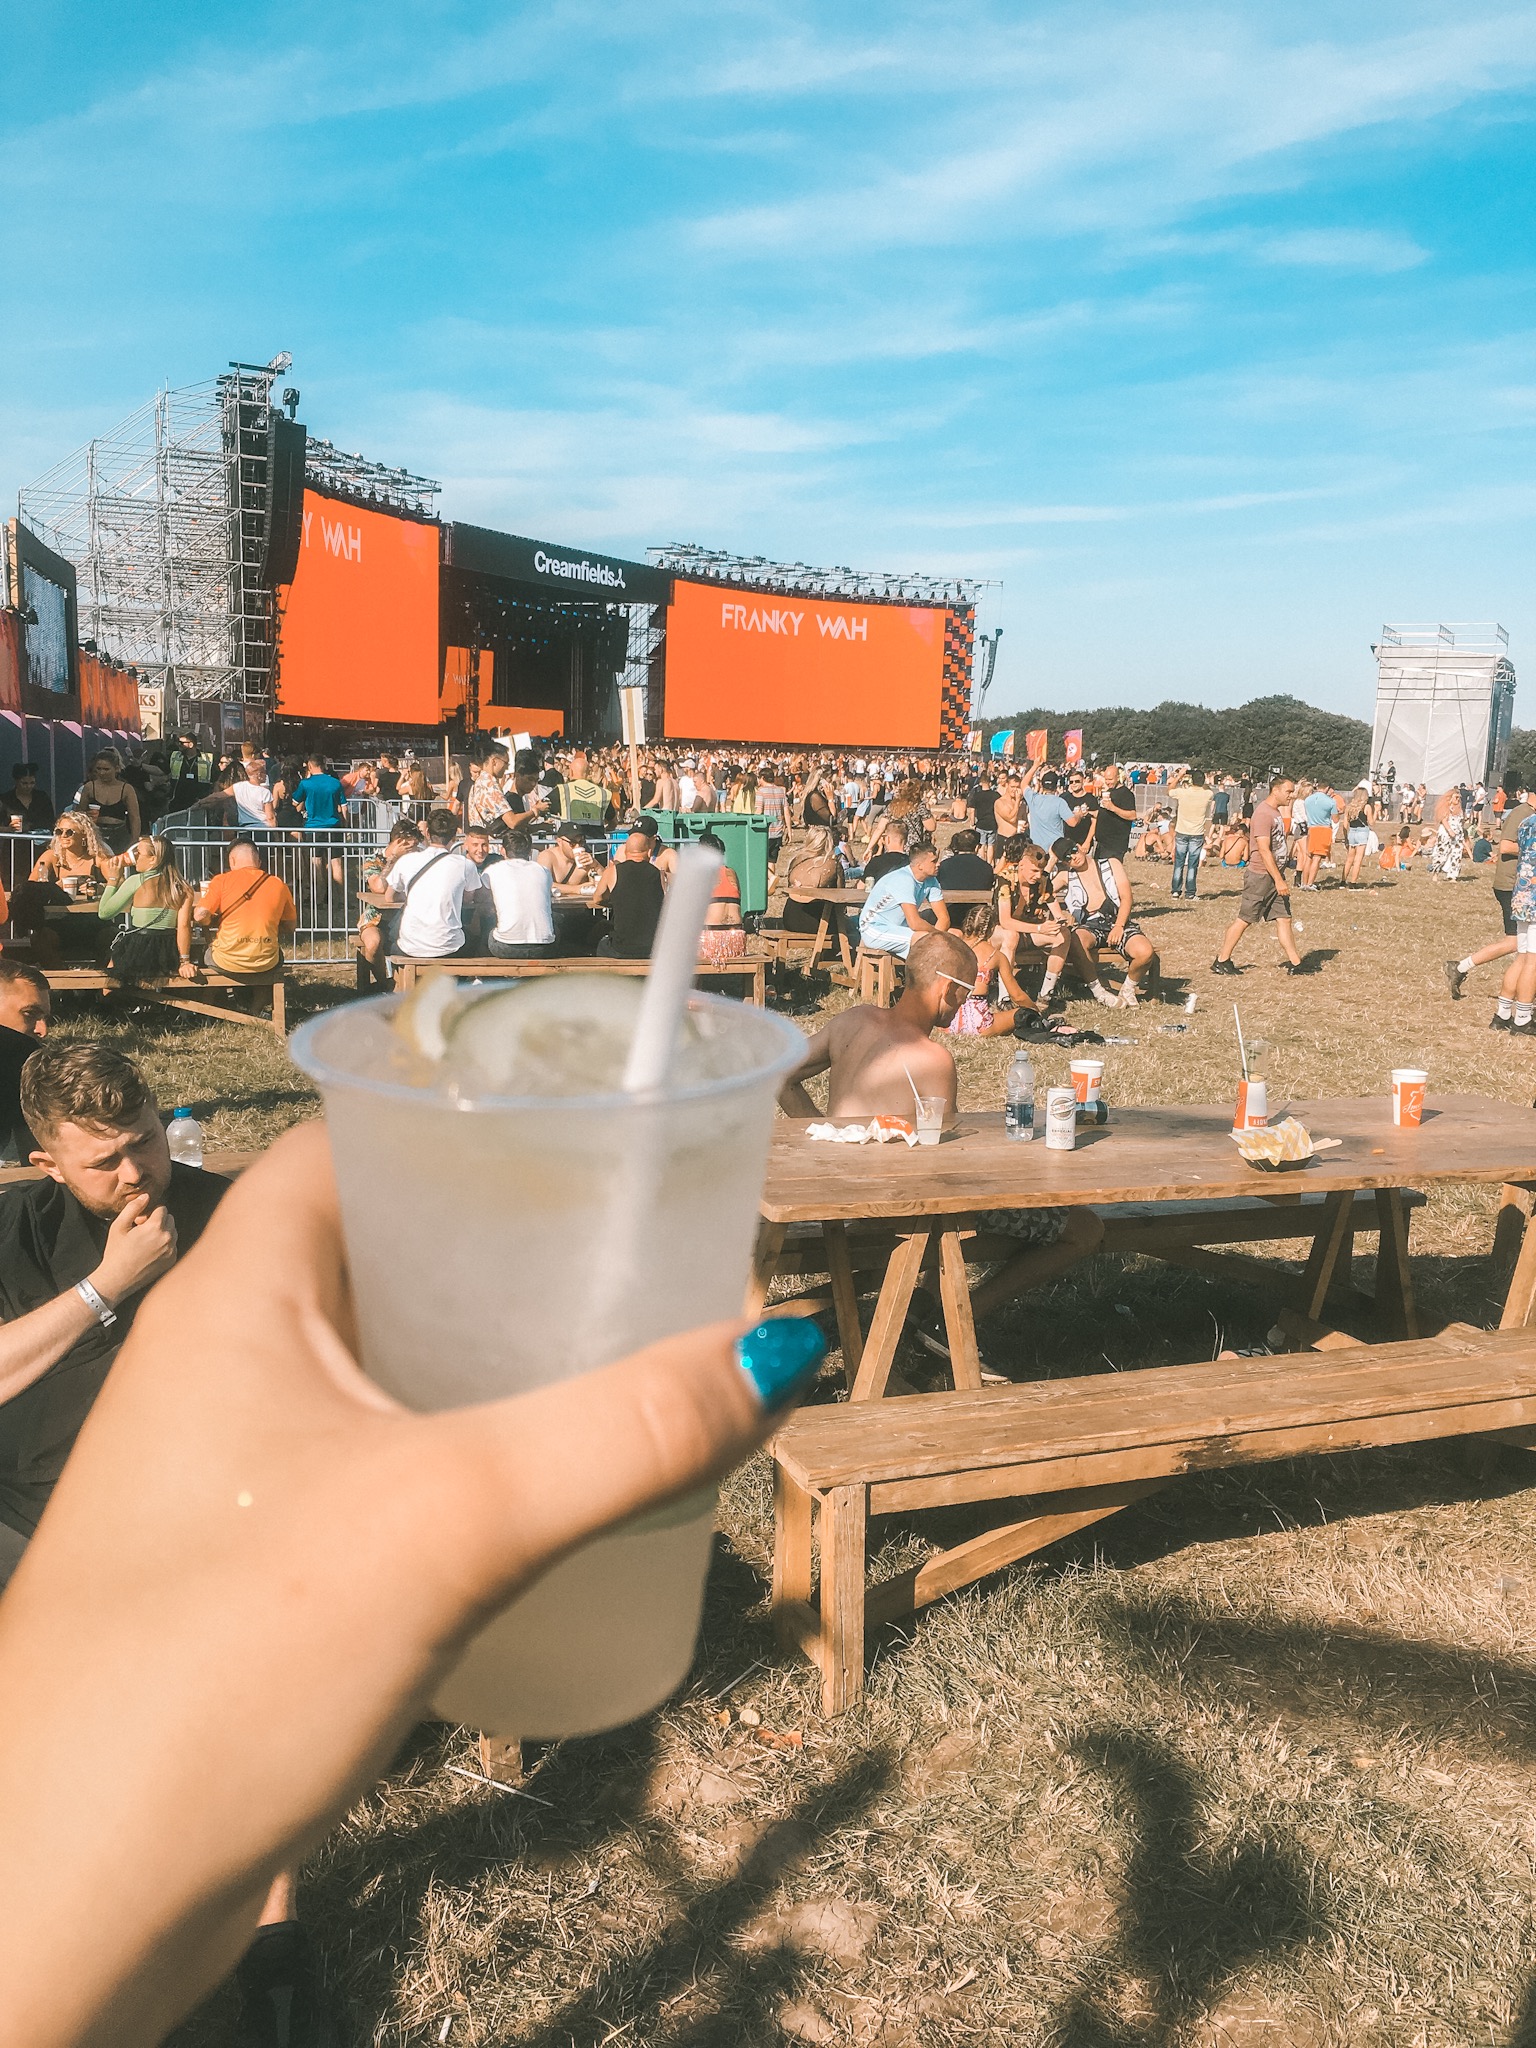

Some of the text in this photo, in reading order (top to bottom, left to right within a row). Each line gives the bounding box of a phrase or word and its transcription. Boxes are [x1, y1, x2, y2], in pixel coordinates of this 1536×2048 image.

[320, 515, 362, 563] WAH
[534, 550, 616, 587] Creamfields
[721, 603, 868, 641] FRANKY WAH
